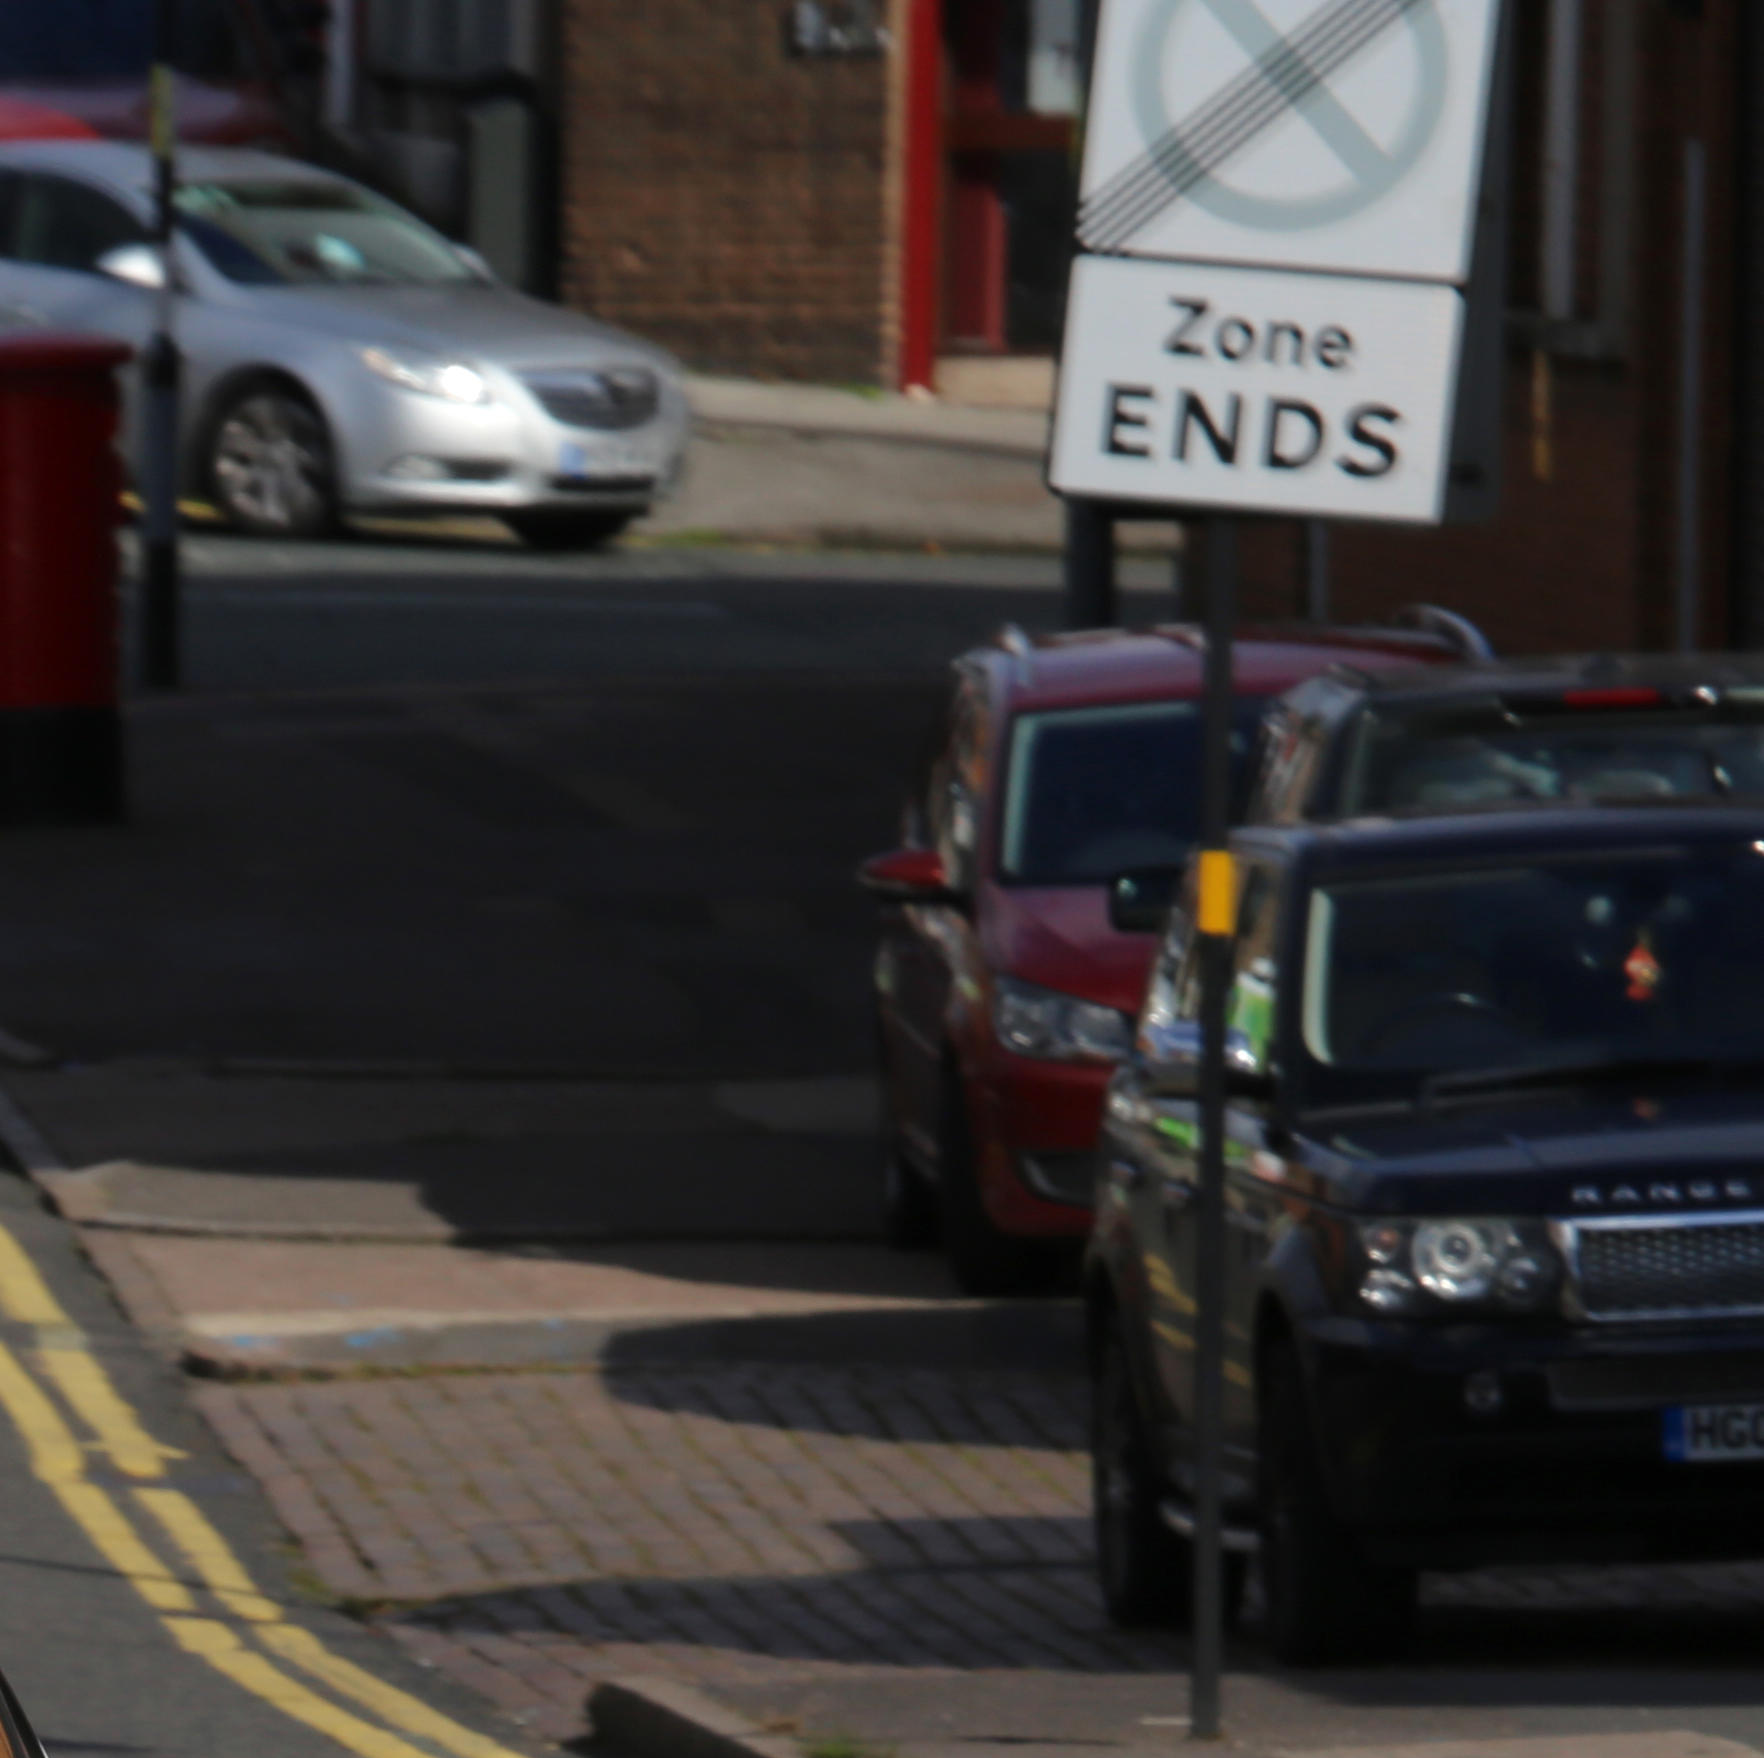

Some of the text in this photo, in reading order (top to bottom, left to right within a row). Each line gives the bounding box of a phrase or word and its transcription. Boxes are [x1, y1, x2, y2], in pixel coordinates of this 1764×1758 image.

[1163, 295, 1354, 369] Zone
[1102, 382, 1403, 478] ENDS
[1569, 1178, 1752, 1205] RANGE
